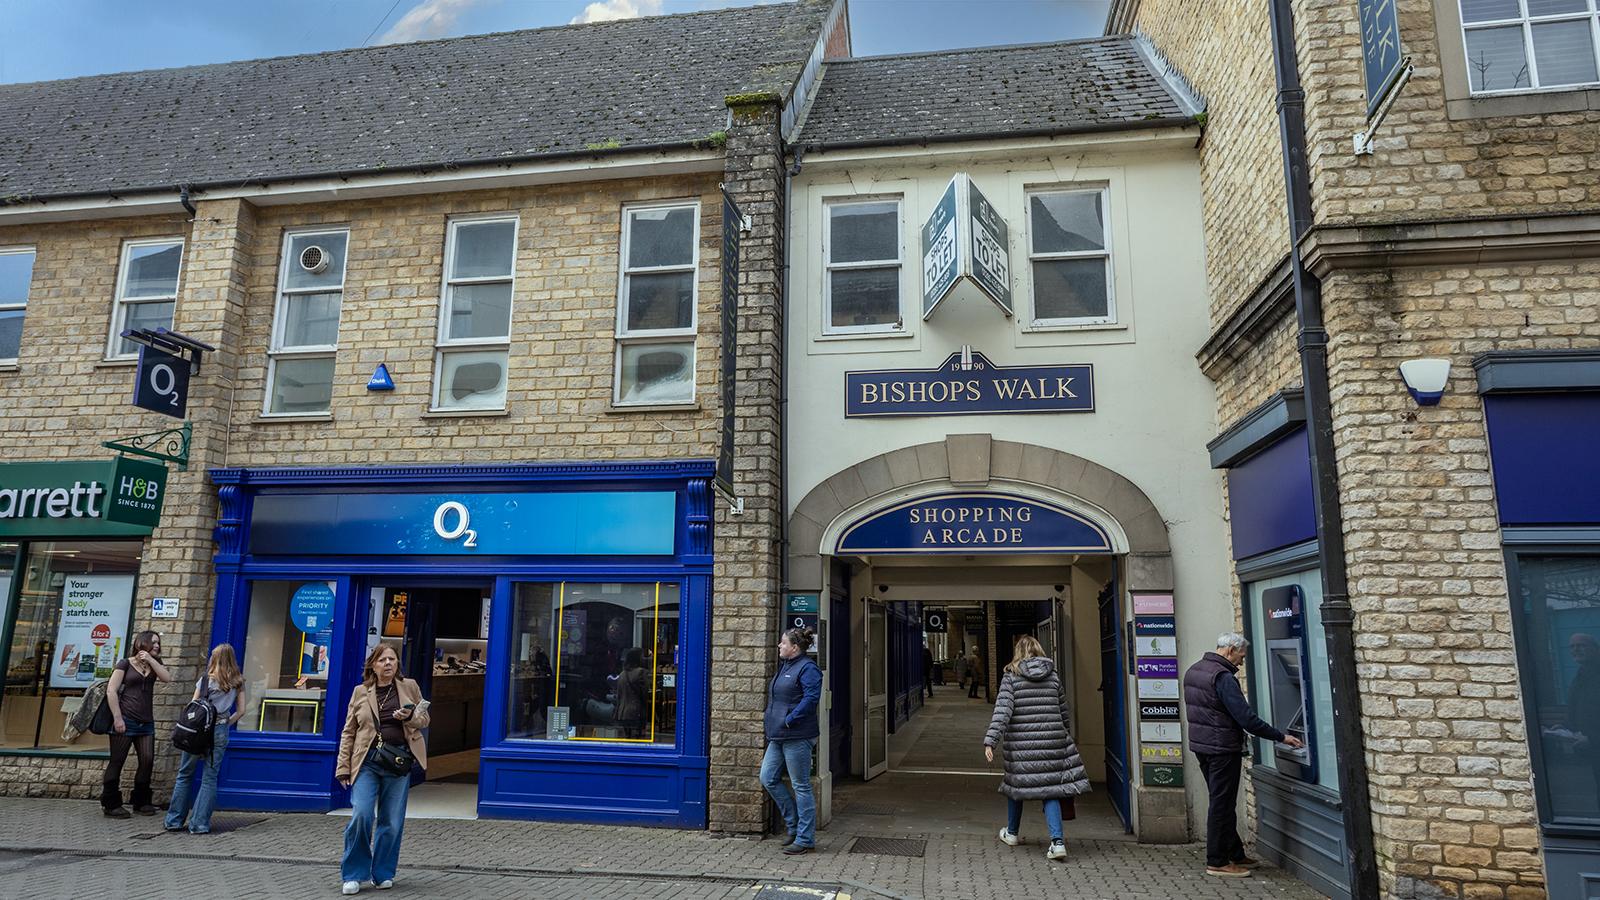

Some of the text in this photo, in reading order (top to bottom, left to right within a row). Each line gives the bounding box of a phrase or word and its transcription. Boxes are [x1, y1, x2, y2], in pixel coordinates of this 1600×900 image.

[931, 231, 948, 262] SHOPS
[926, 266, 938, 287] TO
[939, 238, 954, 272] LET
[975, 236, 990, 263] TO
[991, 253, 1007, 284] LET
[150, 363, 180, 407] O2
[860, 377, 1078, 404] BISHOPS WALK
[119, 475, 159, 501] H&B
[0, 481, 103, 518] arrett
[117, 497, 156, 511] SINCE 1870
[909, 506, 1032, 524] SHOPPING
[433, 501, 478, 547] O2
[921, 527, 1024, 544] ARCADE
[70, 580, 90, 589] Your
[68, 590, 104, 600] stronger
[67, 599, 88, 609] body
[66, 609, 110, 617] starts here.
[1272, 607, 1293, 618] nationwide
[929, 615, 944, 630] O2
[97, 630, 105, 638] for
[1142, 706, 1178, 715] Cobbler
[1142, 748, 1157, 758] MY
